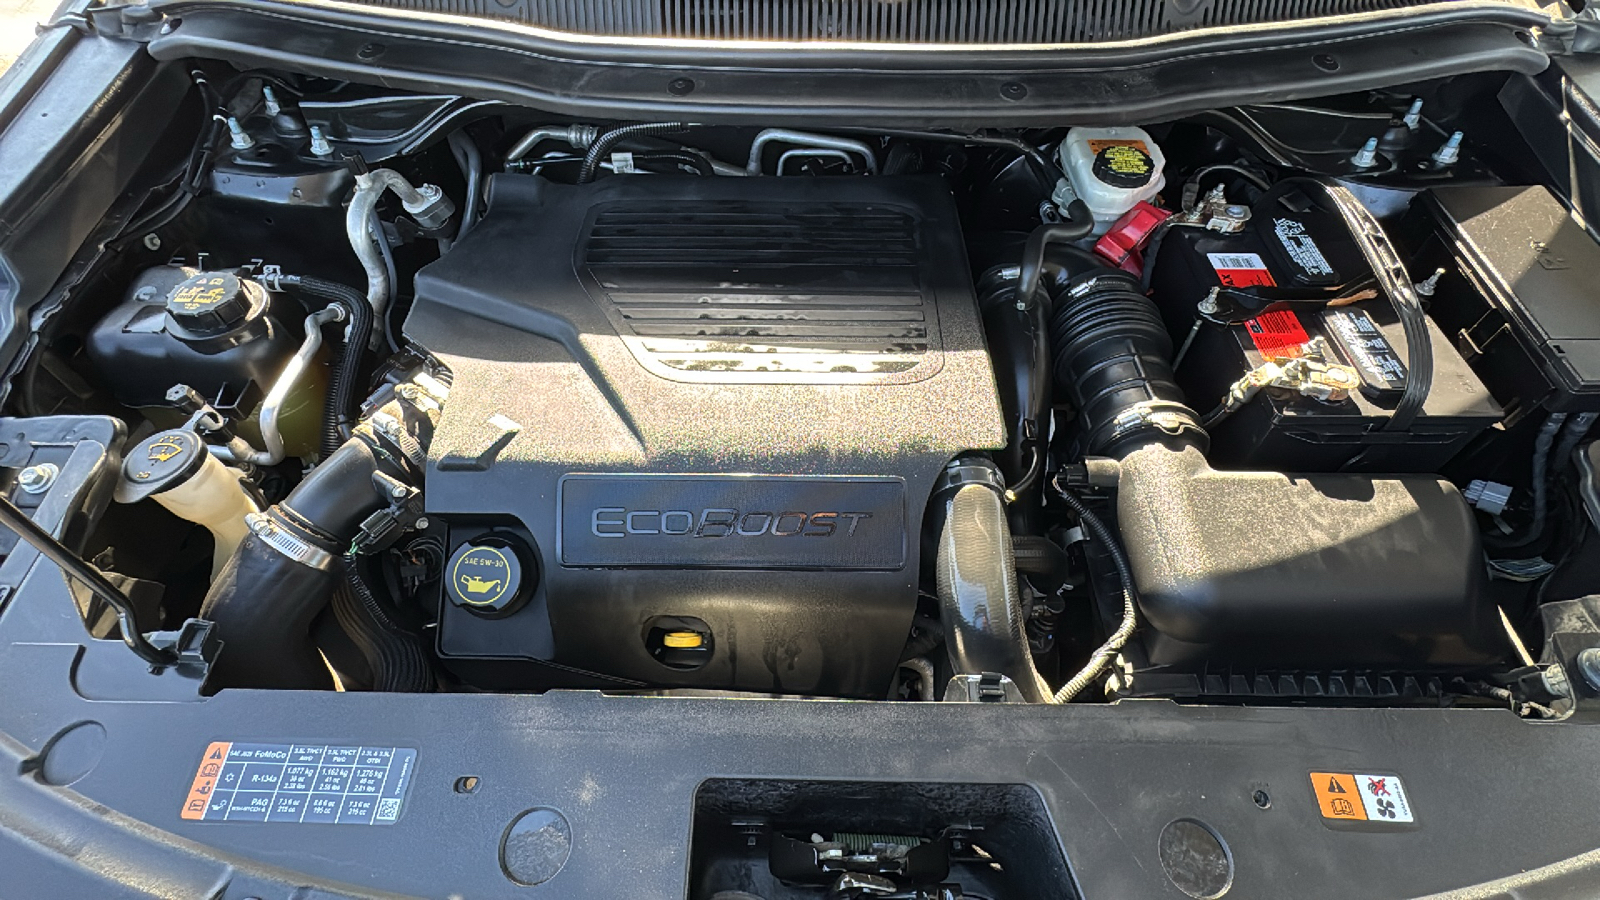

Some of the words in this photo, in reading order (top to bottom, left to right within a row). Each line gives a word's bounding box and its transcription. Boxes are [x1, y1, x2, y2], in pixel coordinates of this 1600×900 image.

[464, 557, 478, 565] SAE
[480, 558, 504, 568] 5W-30
[254, 750, 287, 759] FoMoCo
[304, 767, 314, 777] kg
[339, 768, 349, 777] kg
[374, 770, 383, 779] kg
[251, 774, 277, 782] R-134a
[251, 798, 268, 806] PAG
